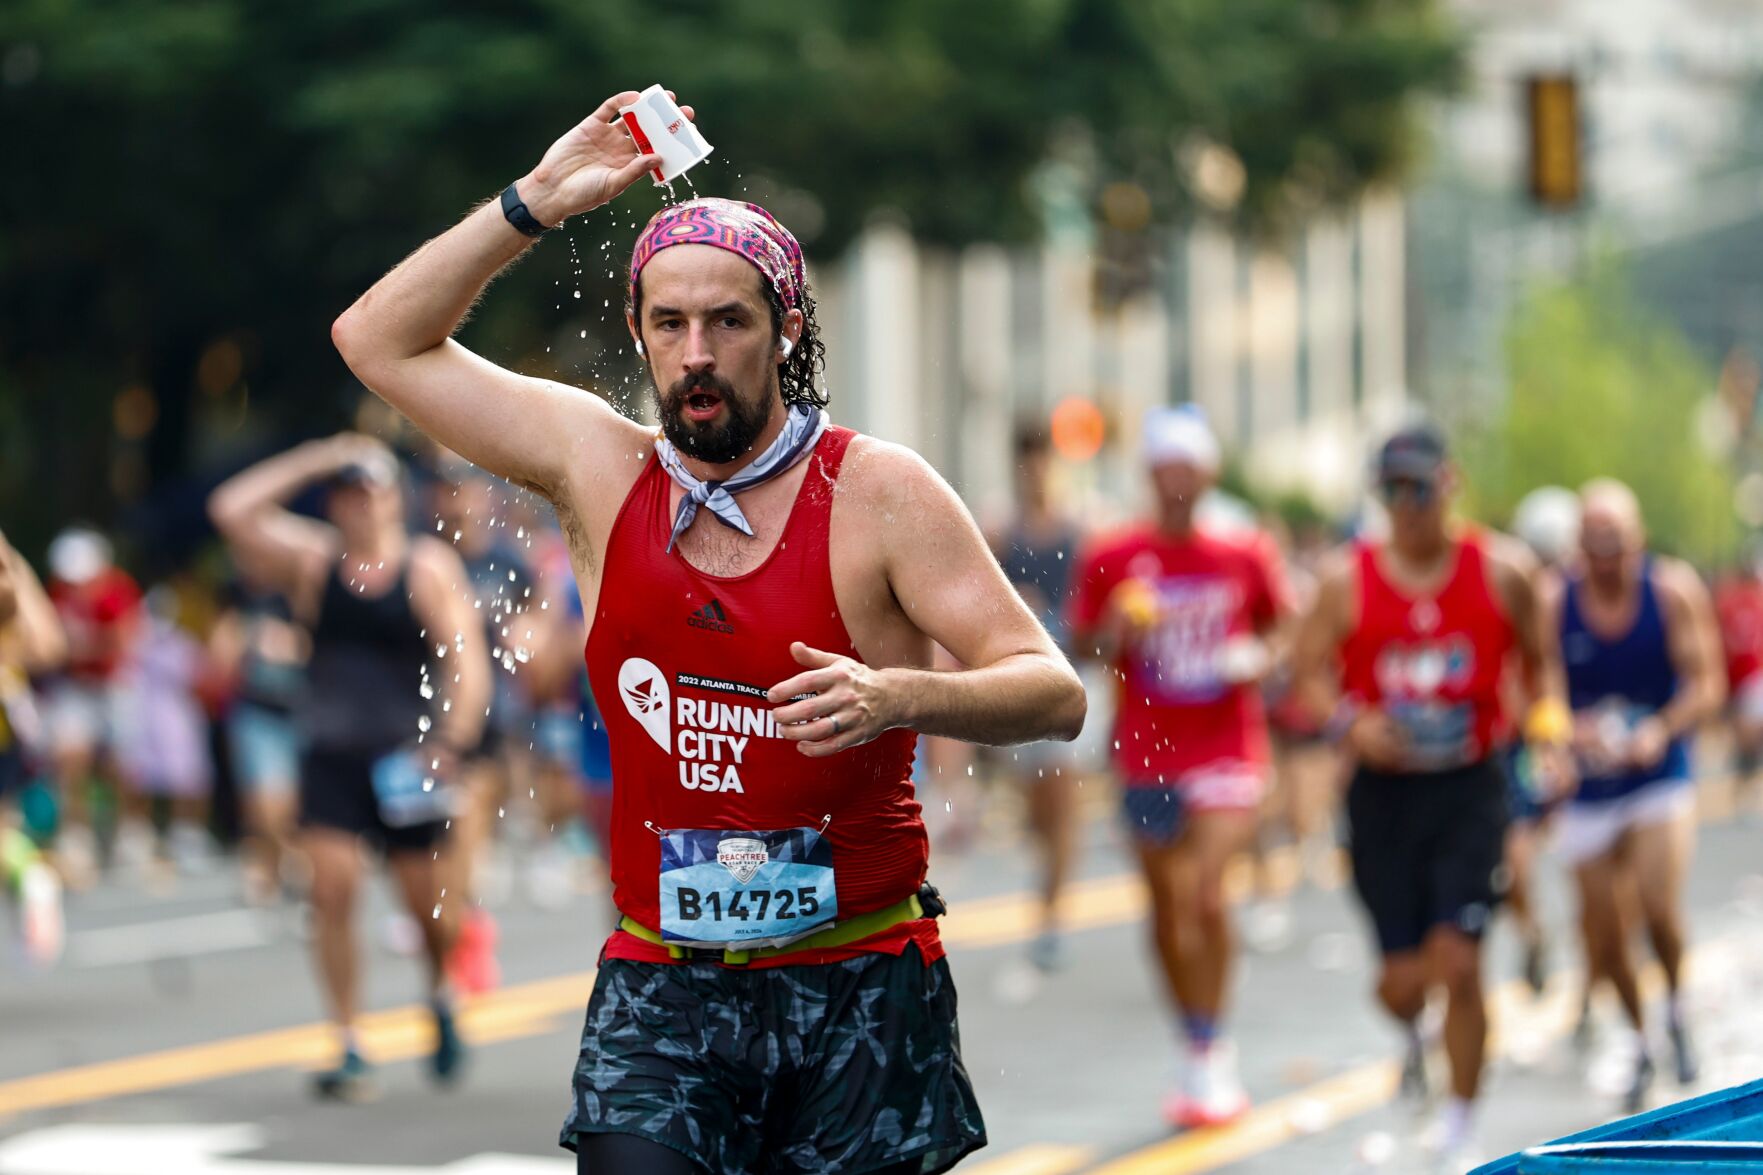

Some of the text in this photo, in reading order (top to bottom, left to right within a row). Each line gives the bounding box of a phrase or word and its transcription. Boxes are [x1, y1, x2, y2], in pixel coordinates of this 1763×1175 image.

[688, 615, 734, 634] adidas
[678, 675, 699, 685] 2022
[700, 679, 735, 691] ATLANTA
[736, 684, 760, 696] TRACK
[678, 729, 749, 763] CITY
[679, 760, 745, 794] USA
[719, 853, 766, 861] PEACHTREE
[677, 886, 820, 922] B14725
